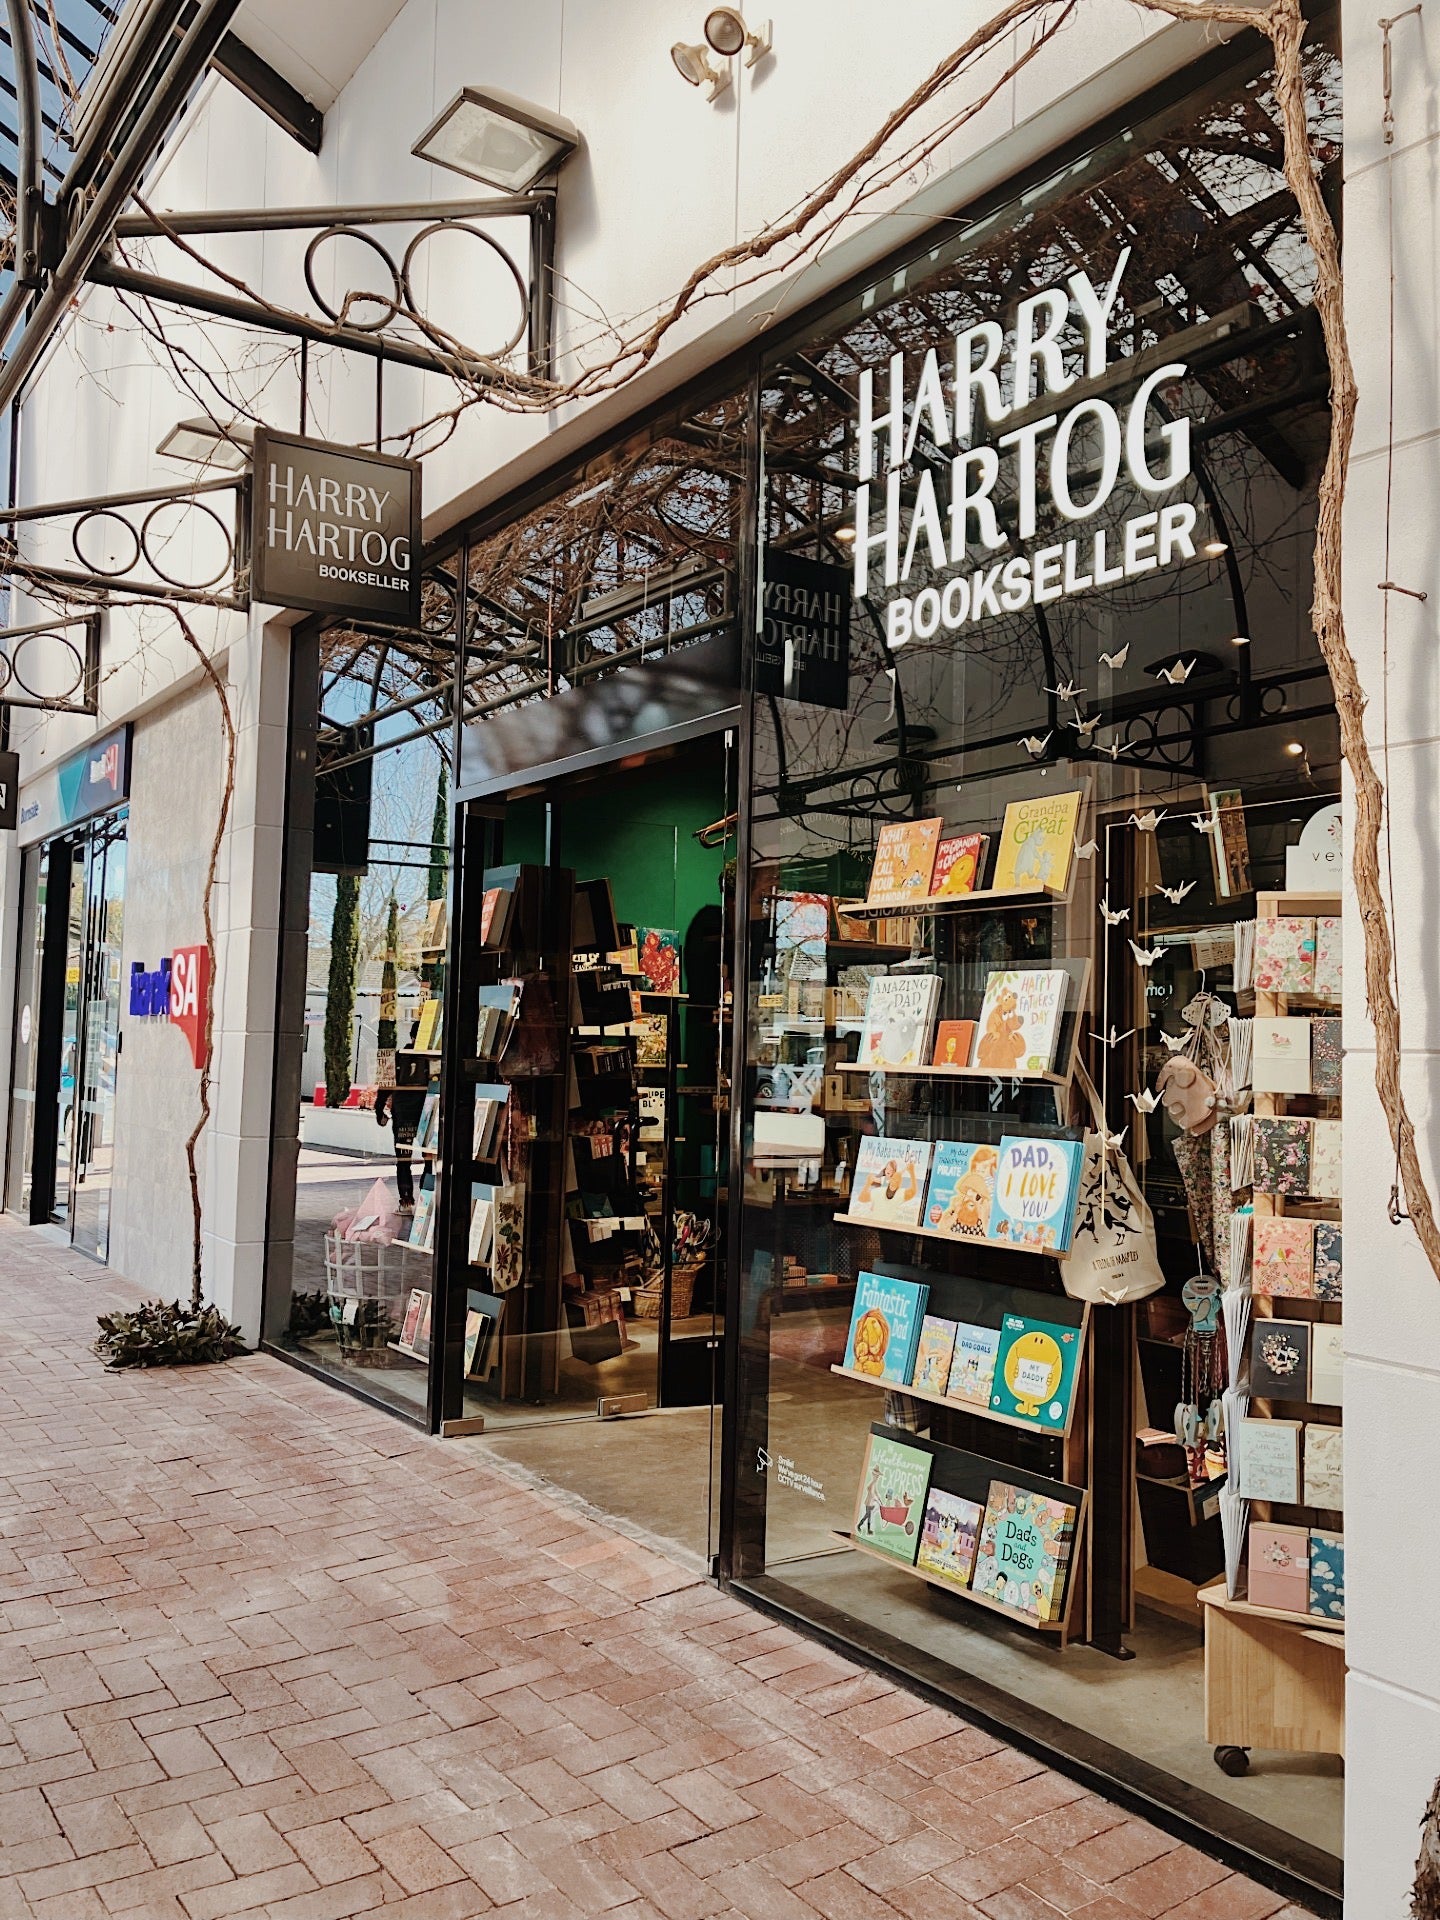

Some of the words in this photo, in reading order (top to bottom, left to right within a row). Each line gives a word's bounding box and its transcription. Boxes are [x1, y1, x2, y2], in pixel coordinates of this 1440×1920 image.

[855, 246, 1131, 481] HARRY
[852, 363, 1190, 597] HARTOG
[268, 463, 390, 523] HARRY
[267, 508, 410, 571] HARTOG
[319, 564, 409, 591] BOOKSELLER
[887, 503, 1196, 649] BOOKSELLER
[1018, 800, 1069, 821] Grandpa
[882, 827, 906, 844] WHAT
[1013, 816, 1067, 844] Great
[879, 845, 891, 859] DO
[894, 843, 911, 858] YOU
[876, 861, 893, 875] CALL
[873, 877, 894, 891] YOUR
[872, 978, 929, 995] AMAZING
[1021, 973, 1055, 992] HAPPY
[893, 992, 921, 1008] DAD
[1031, 1011, 1049, 1025] DAY
[904, 1144, 923, 1164] Best
[1010, 1145, 1054, 1169] DAD,
[937, 1164, 962, 1178] PIRATE
[1005, 1174, 1013, 1197] I
[1019, 1172, 1057, 1199] LOVE
[1022, 1200, 1048, 1219] YOU!
[860, 1283, 911, 1317] Fantastic
[892, 1318, 907, 1340] Dad
[961, 1341, 972, 1350] DAD
[973, 1344, 991, 1354] GOALS
[1022, 1372, 1045, 1383] DADDY
[1030, 1364, 1040, 1372] MY
[778, 1474, 794, 1487] CCTV
[880, 1467, 924, 1496] EXPRESS
[1005, 1520, 1038, 1547] Dads
[1014, 1542, 1027, 1551] and
[1001, 1544, 1035, 1570] Dogs
